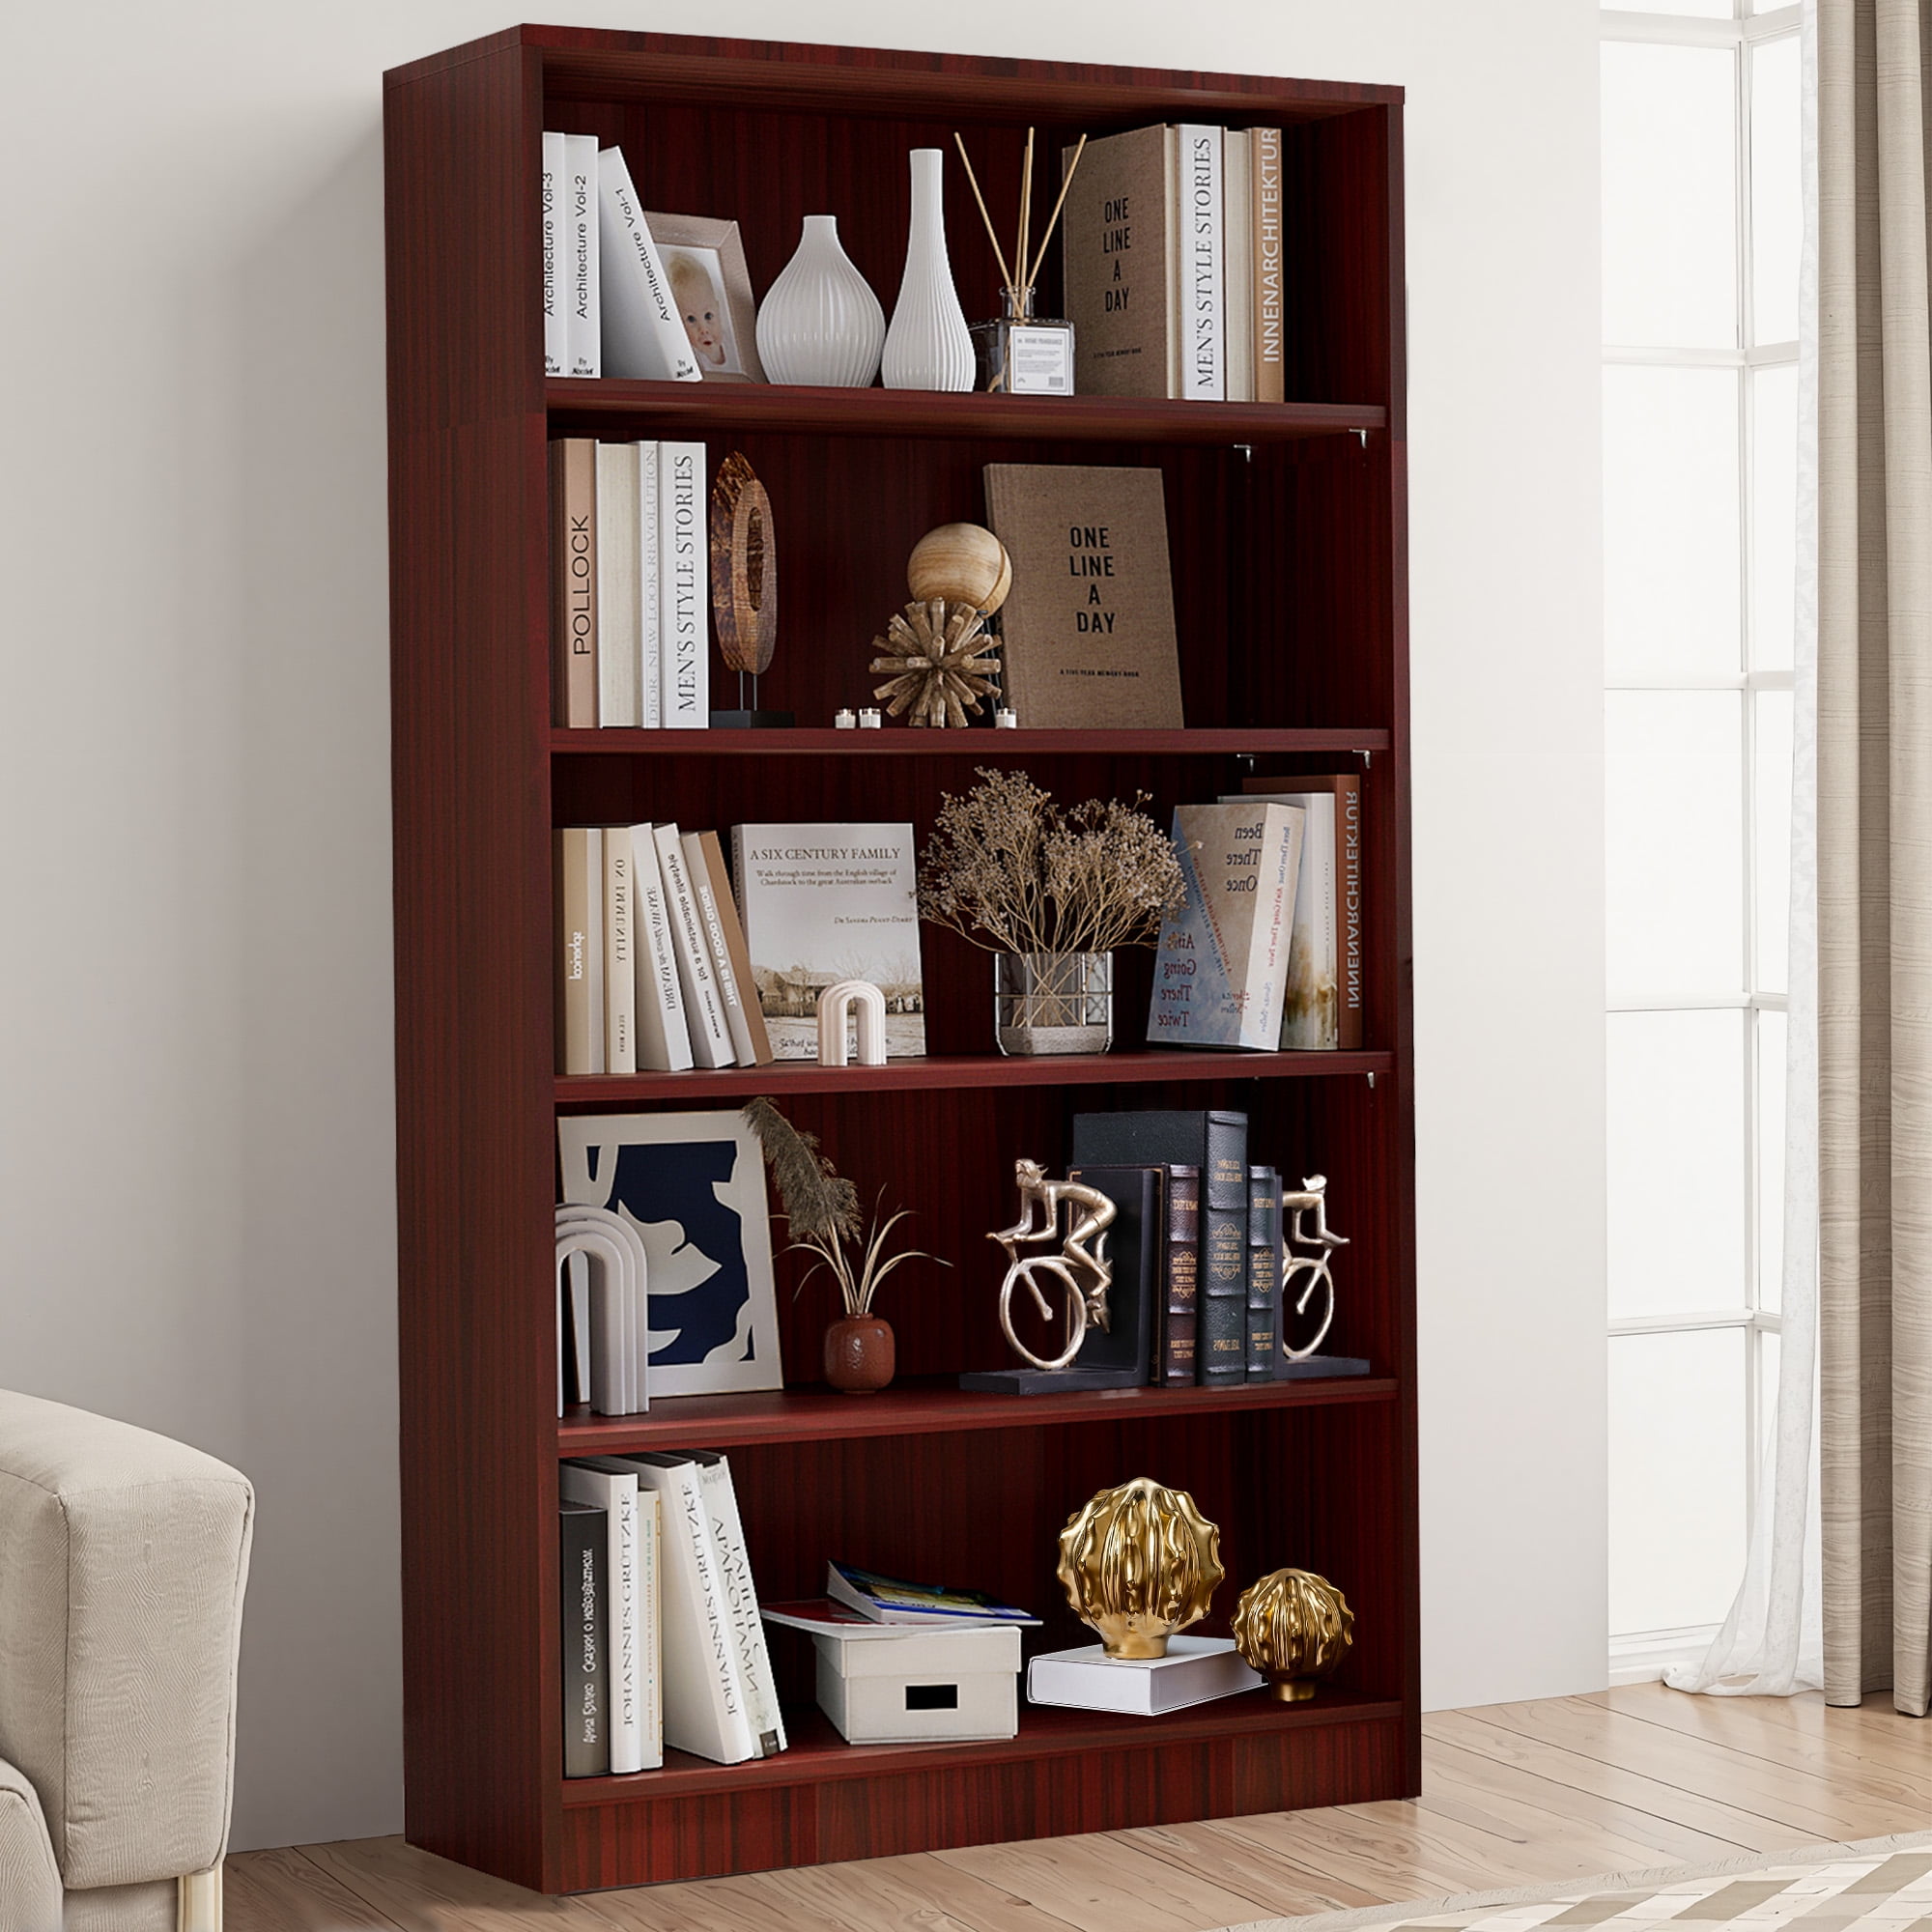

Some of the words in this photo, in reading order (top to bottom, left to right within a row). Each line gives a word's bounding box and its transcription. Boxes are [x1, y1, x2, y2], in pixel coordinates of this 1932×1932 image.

[575, 175, 587, 217] Vol-2
[615, 187, 636, 228] Vol-1
[1194, 137, 1213, 234] STORIES
[1104, 197, 1129, 223] ONE
[1103, 226, 1131, 254] LINE
[1262, 128, 1280, 362] INNENARCHITEKTUR
[543, 220, 554, 317] Architecture
[576, 223, 588, 319] Architecture
[633, 231, 670, 321] Architecture
[1113, 259, 1122, 282] A
[1195, 240, 1213, 313] STYLE
[1105, 290, 1130, 312] DAY
[1197, 320, 1214, 387] MEN'S
[646, 449, 657, 564] REVOLUTION
[674, 454, 694, 554] STORIES
[1070, 526, 1110, 549] ONE
[571, 515, 591, 655] POLLOCK
[1069, 555, 1115, 577] LINE
[648, 573, 657, 620] LOOK
[676, 560, 696, 635] STYLE
[1088, 583, 1101, 605] A
[1076, 611, 1116, 634] DAY
[648, 630, 658, 668] NEW
[678, 639, 696, 712] MEN'S
[649, 679, 658, 723] DIOR
[750, 850, 759, 861] A
[762, 849, 784, 860] SIX
[784, 849, 850, 861] CENTURY
[851, 848, 900, 860] FAMILY
[619, 1492, 632, 1603] GRÜTZKE
[680, 1483, 713, 1593] GRÜTZKE
[583, 1623, 594, 1632] о
[582, 1634, 597, 1673] Сказки
[621, 1606, 635, 1727] JOHANNES
[705, 1595, 739, 1716] JOHANNES
[582, 1718, 598, 1744] Анна
